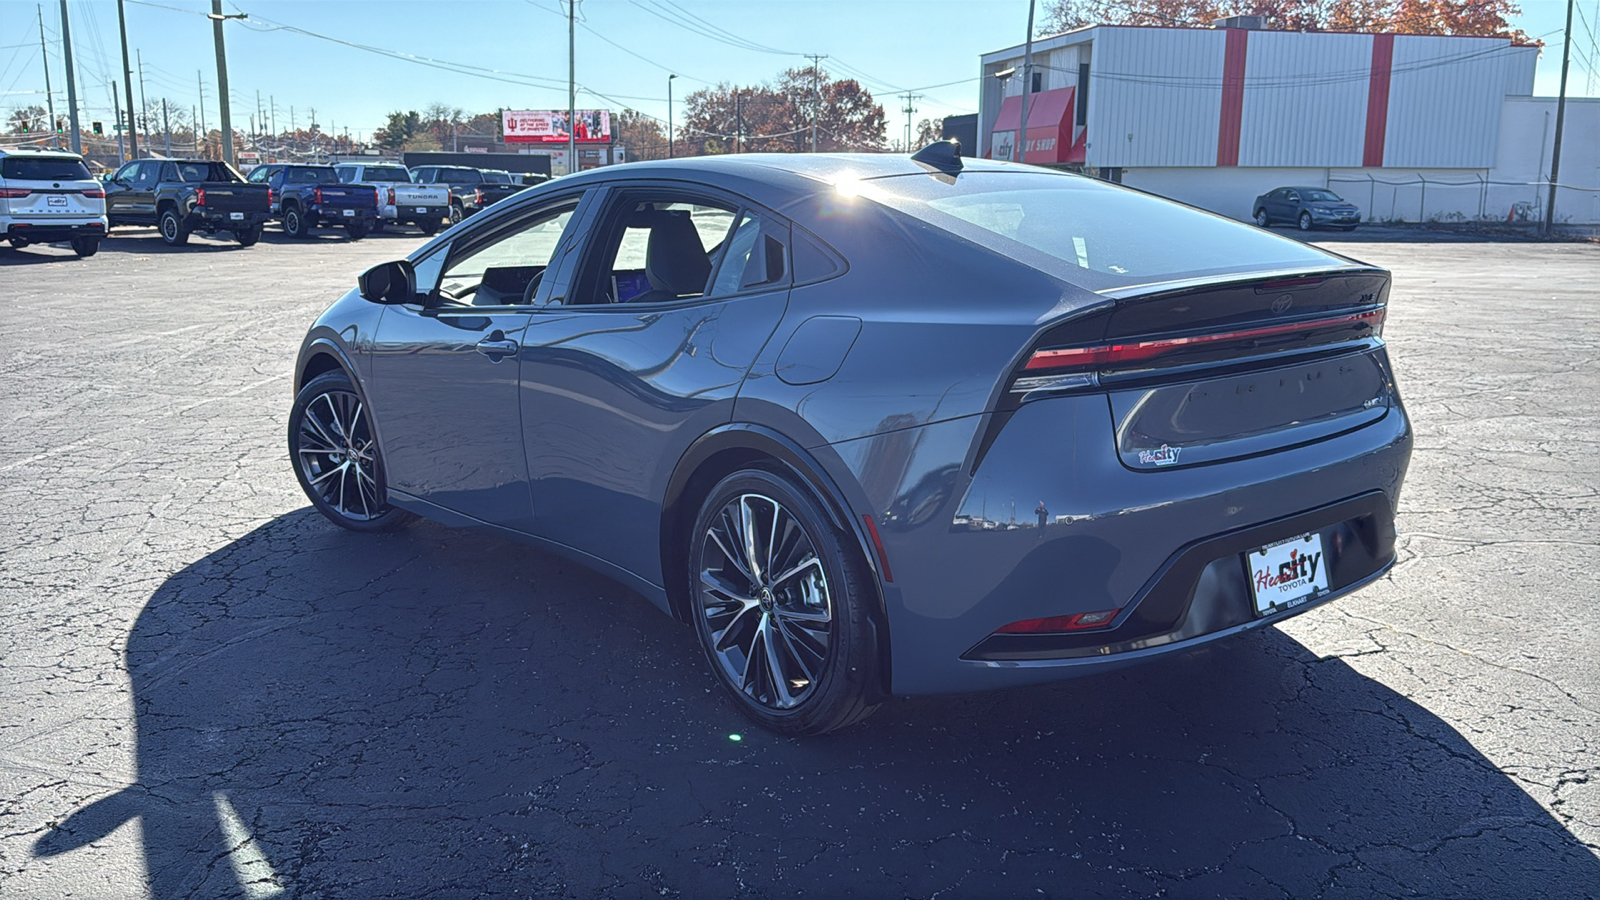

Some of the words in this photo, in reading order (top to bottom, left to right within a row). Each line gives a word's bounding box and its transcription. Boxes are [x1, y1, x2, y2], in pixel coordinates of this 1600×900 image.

[1036, 138, 1056, 151] SHOP
[1278, 579, 1307, 593] TOYOTA
[1287, 596, 1307, 609] ELKHART
